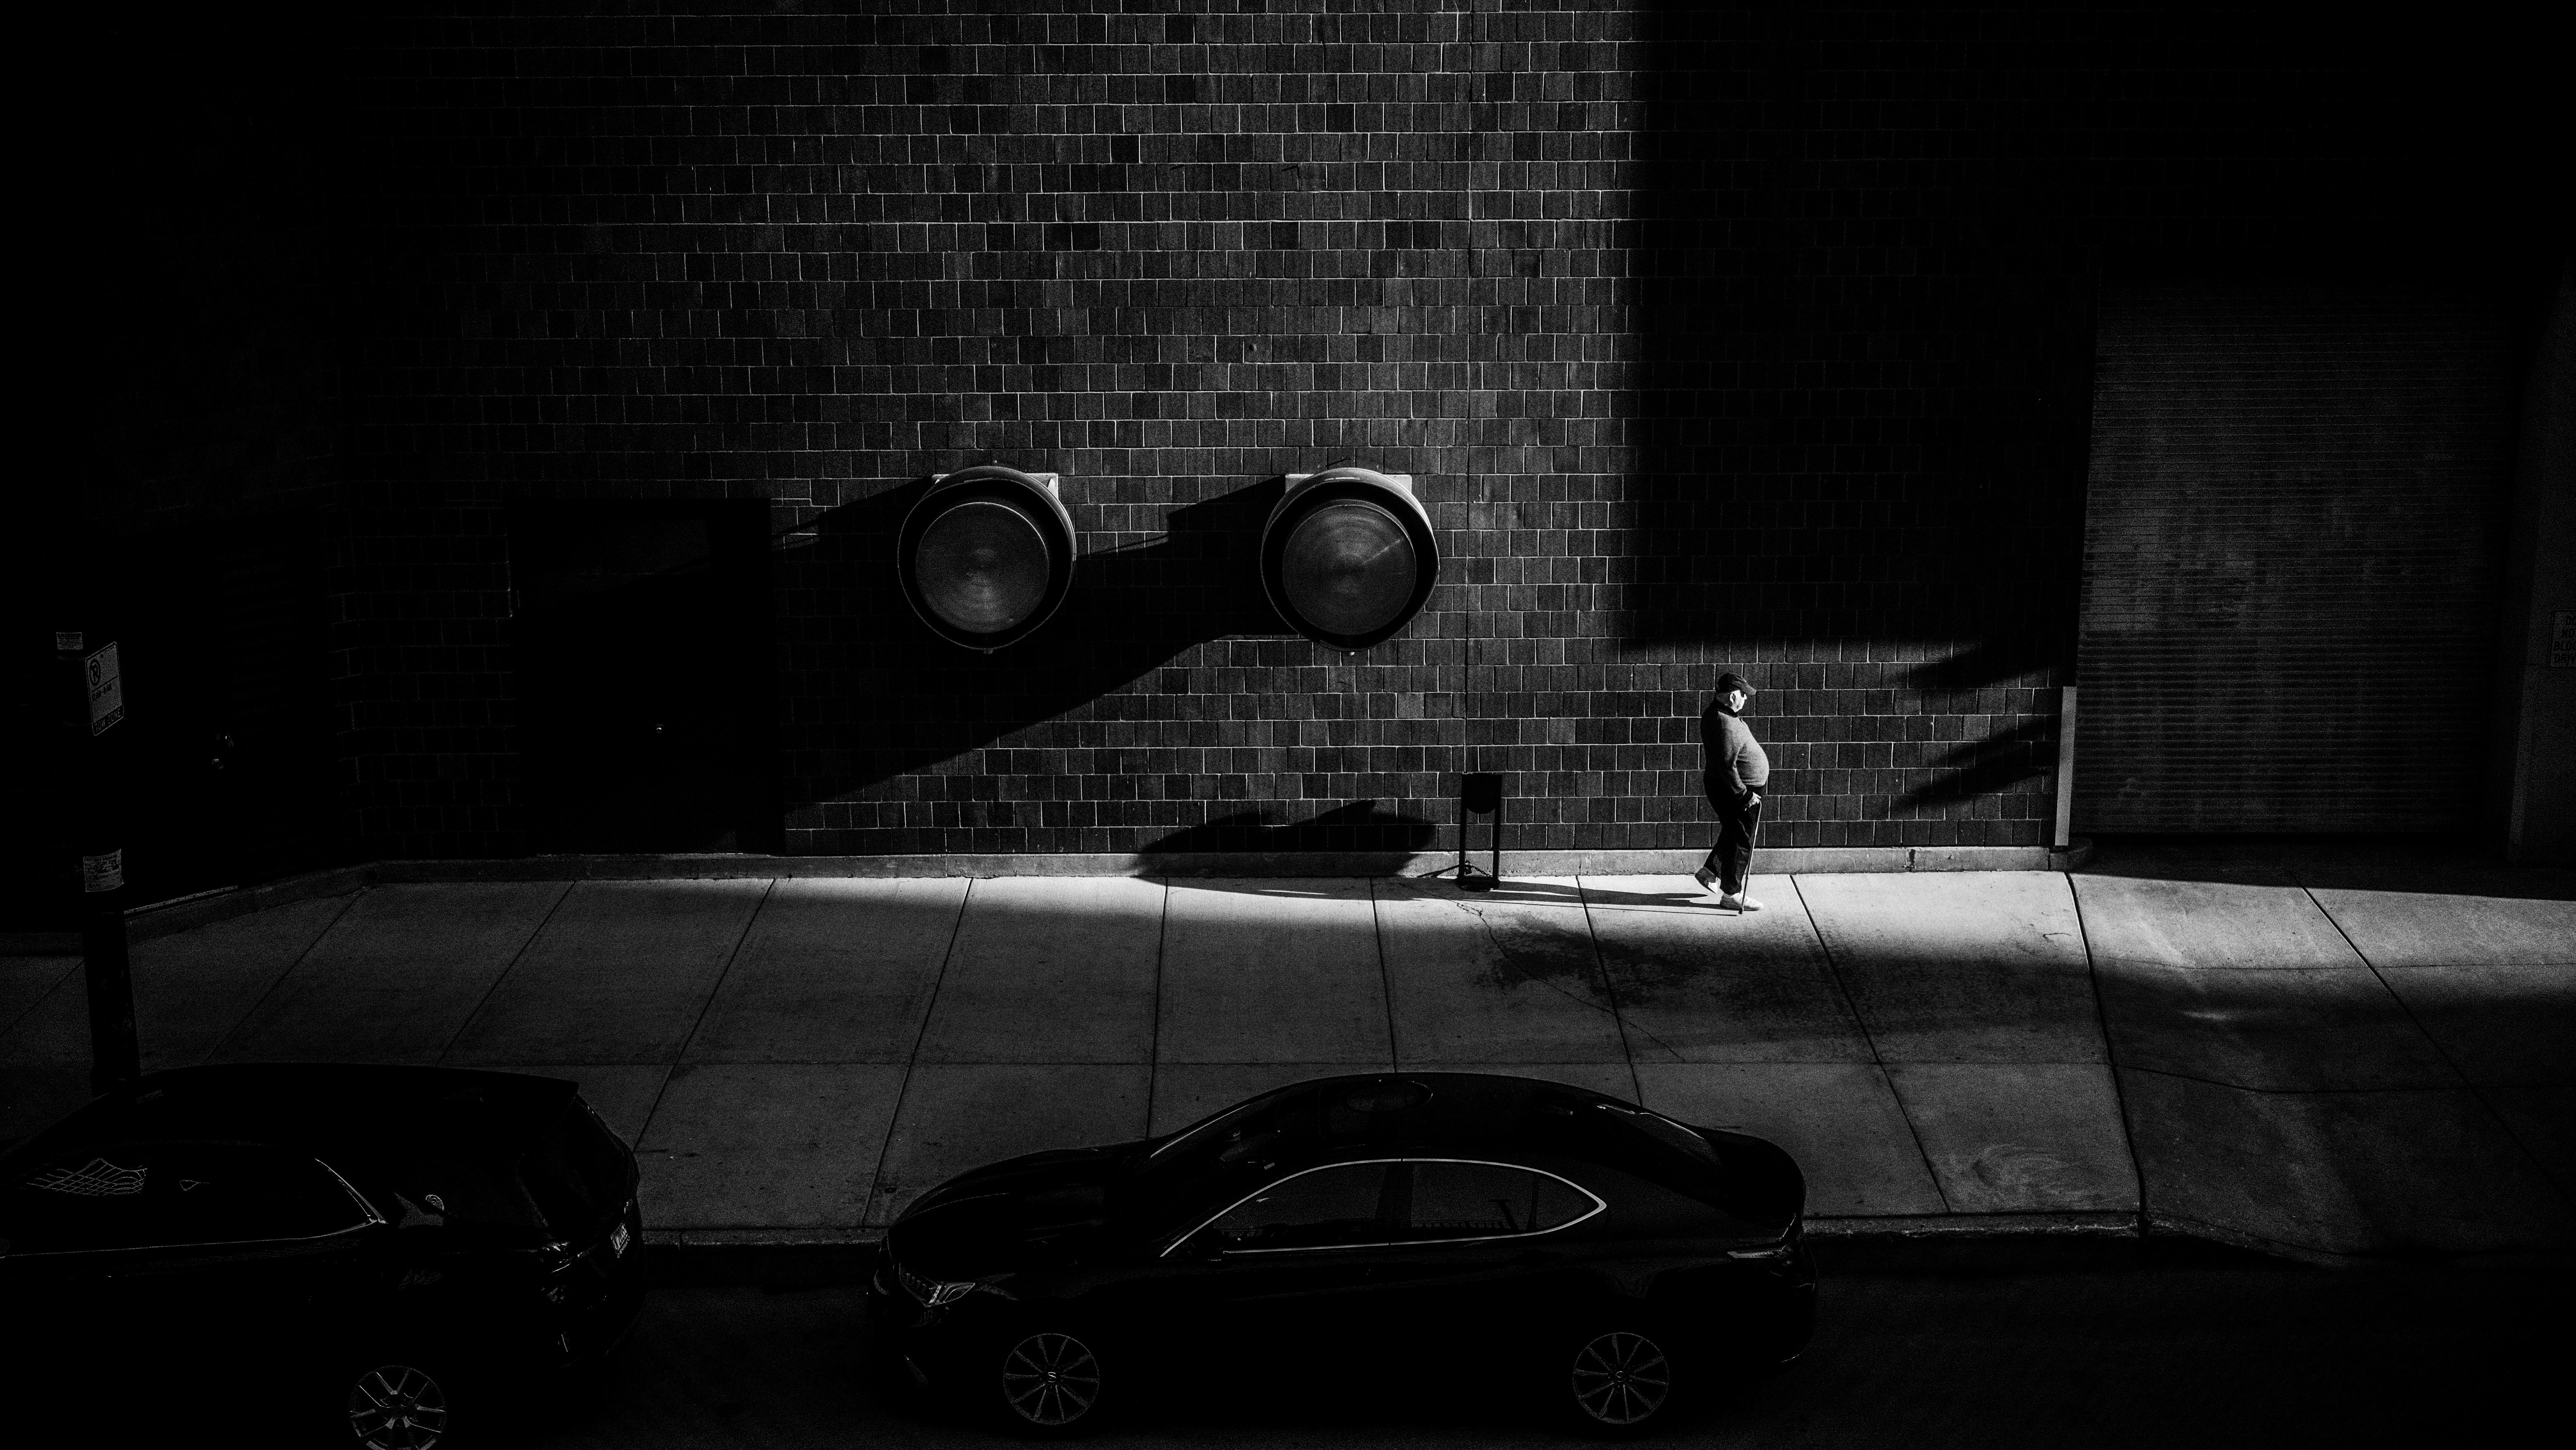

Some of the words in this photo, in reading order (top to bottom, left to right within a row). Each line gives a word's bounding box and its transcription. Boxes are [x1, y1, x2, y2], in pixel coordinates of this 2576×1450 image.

[2562, 628, 2576, 638] NO
[2554, 641, 2576, 651] BLOC
[2554, 654, 2576, 663] DRIV
[94, 719, 106, 732] TOW
[107, 708, 121, 725] ZONE
